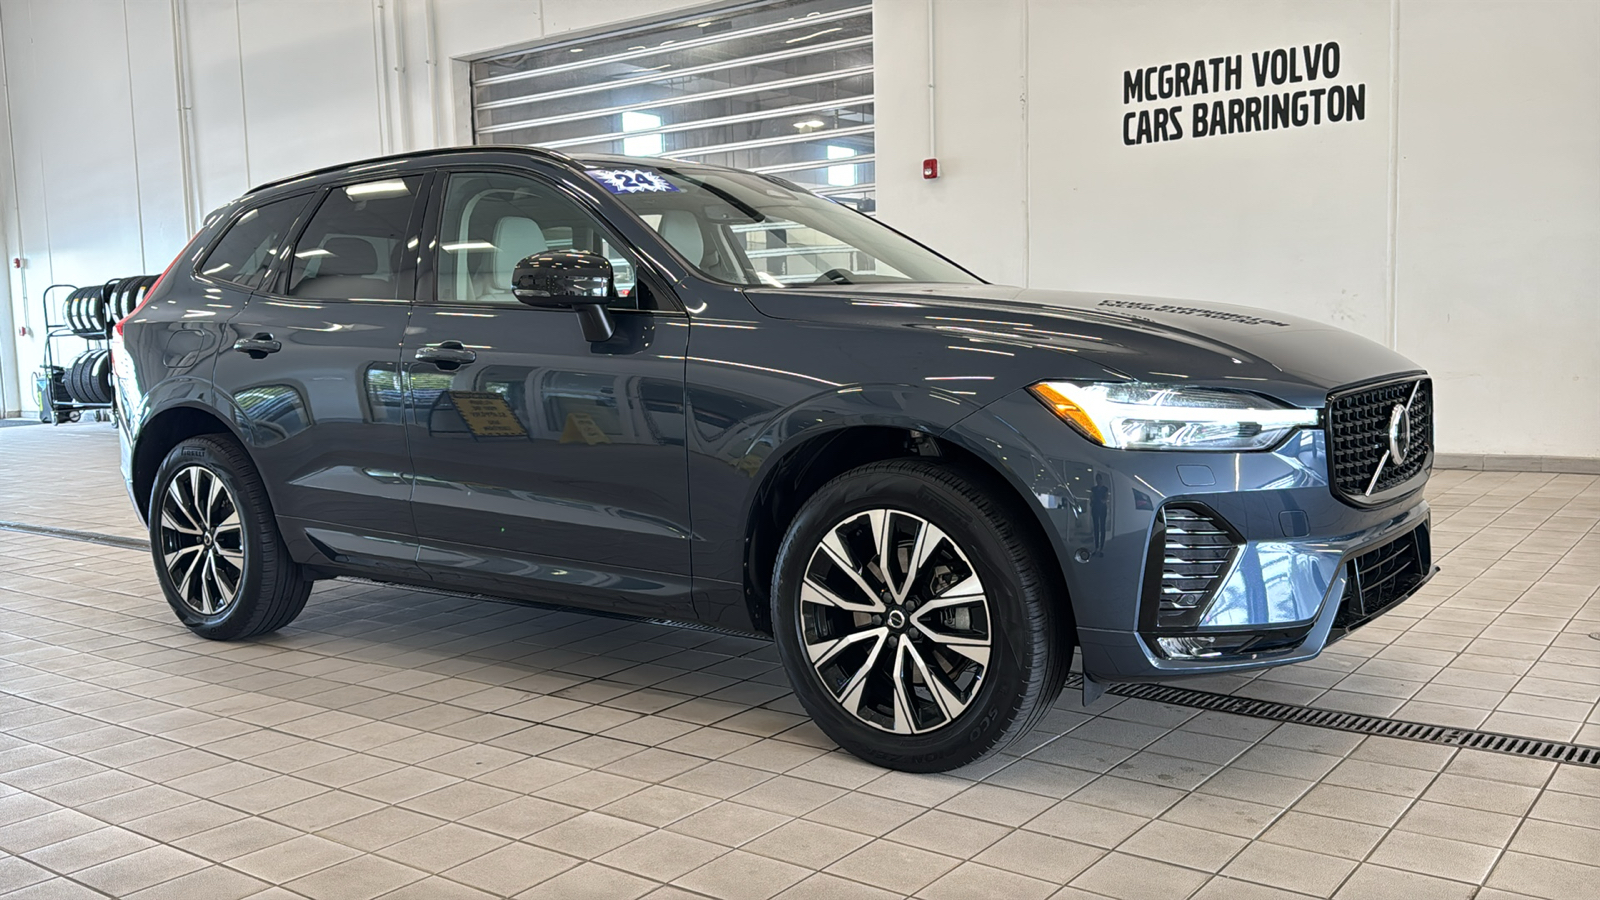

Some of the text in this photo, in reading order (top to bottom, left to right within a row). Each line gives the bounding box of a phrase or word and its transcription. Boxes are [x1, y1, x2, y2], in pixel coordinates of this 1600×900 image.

[1123, 41, 1340, 104] MCGRATH VOLVO
[1123, 83, 1366, 146] CARS BARRINGTON
[614, 173, 655, 188] 24
